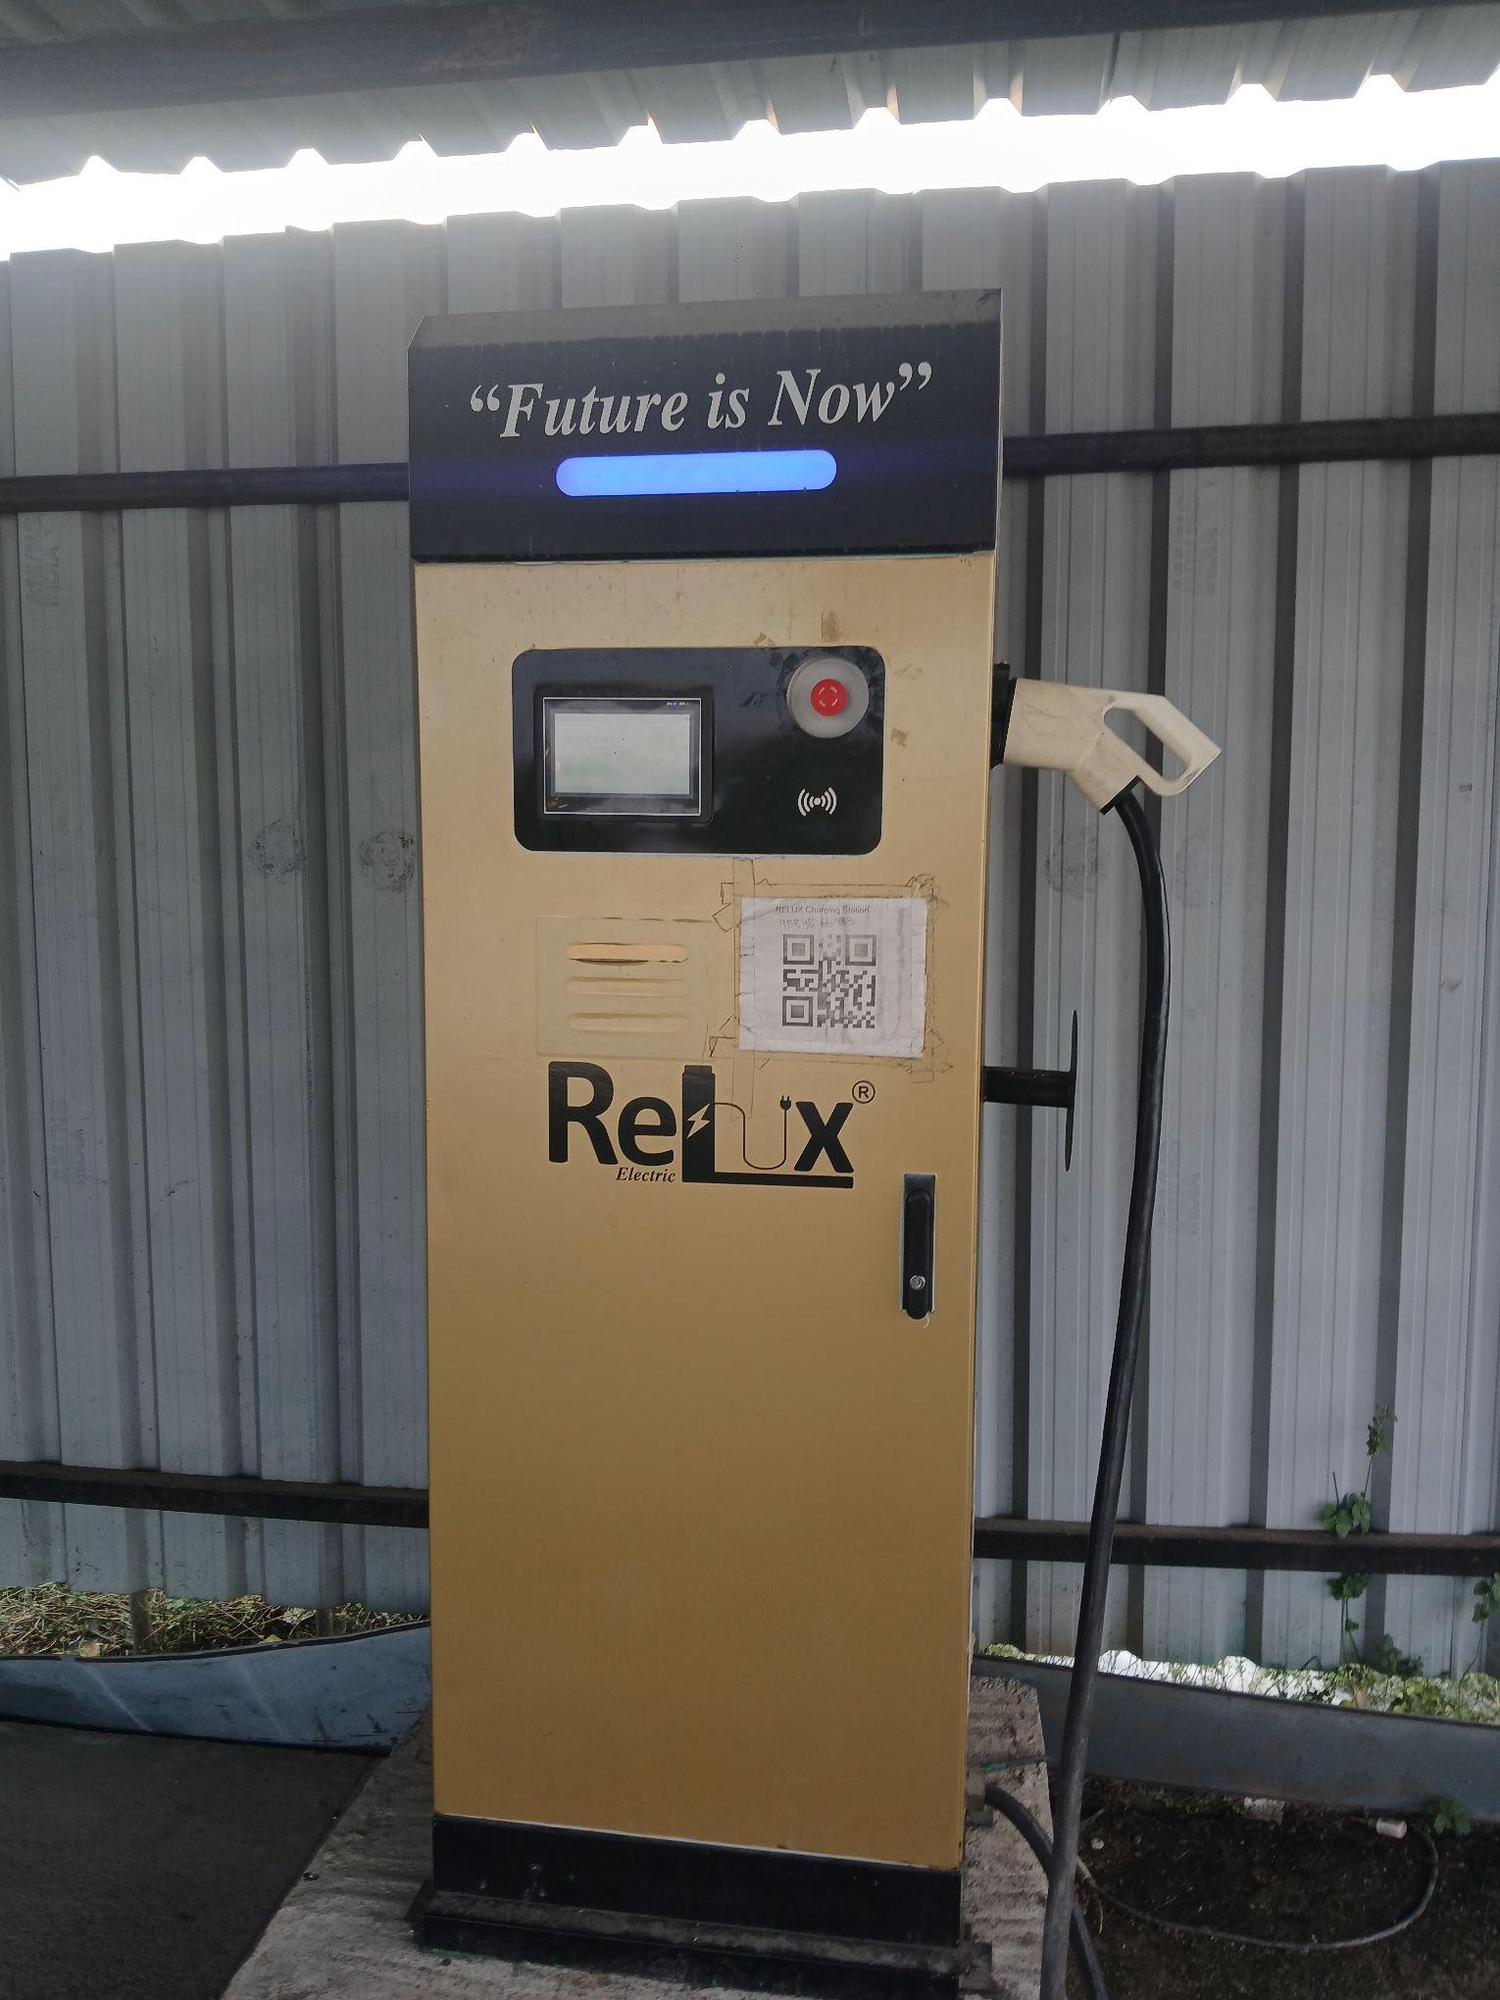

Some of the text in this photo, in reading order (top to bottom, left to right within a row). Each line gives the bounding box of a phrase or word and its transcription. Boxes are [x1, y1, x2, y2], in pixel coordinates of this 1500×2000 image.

[469, 361, 932, 438] “Future is Now”
[842, 904, 870, 914] Station
[615, 1165, 676, 1183] Electric
